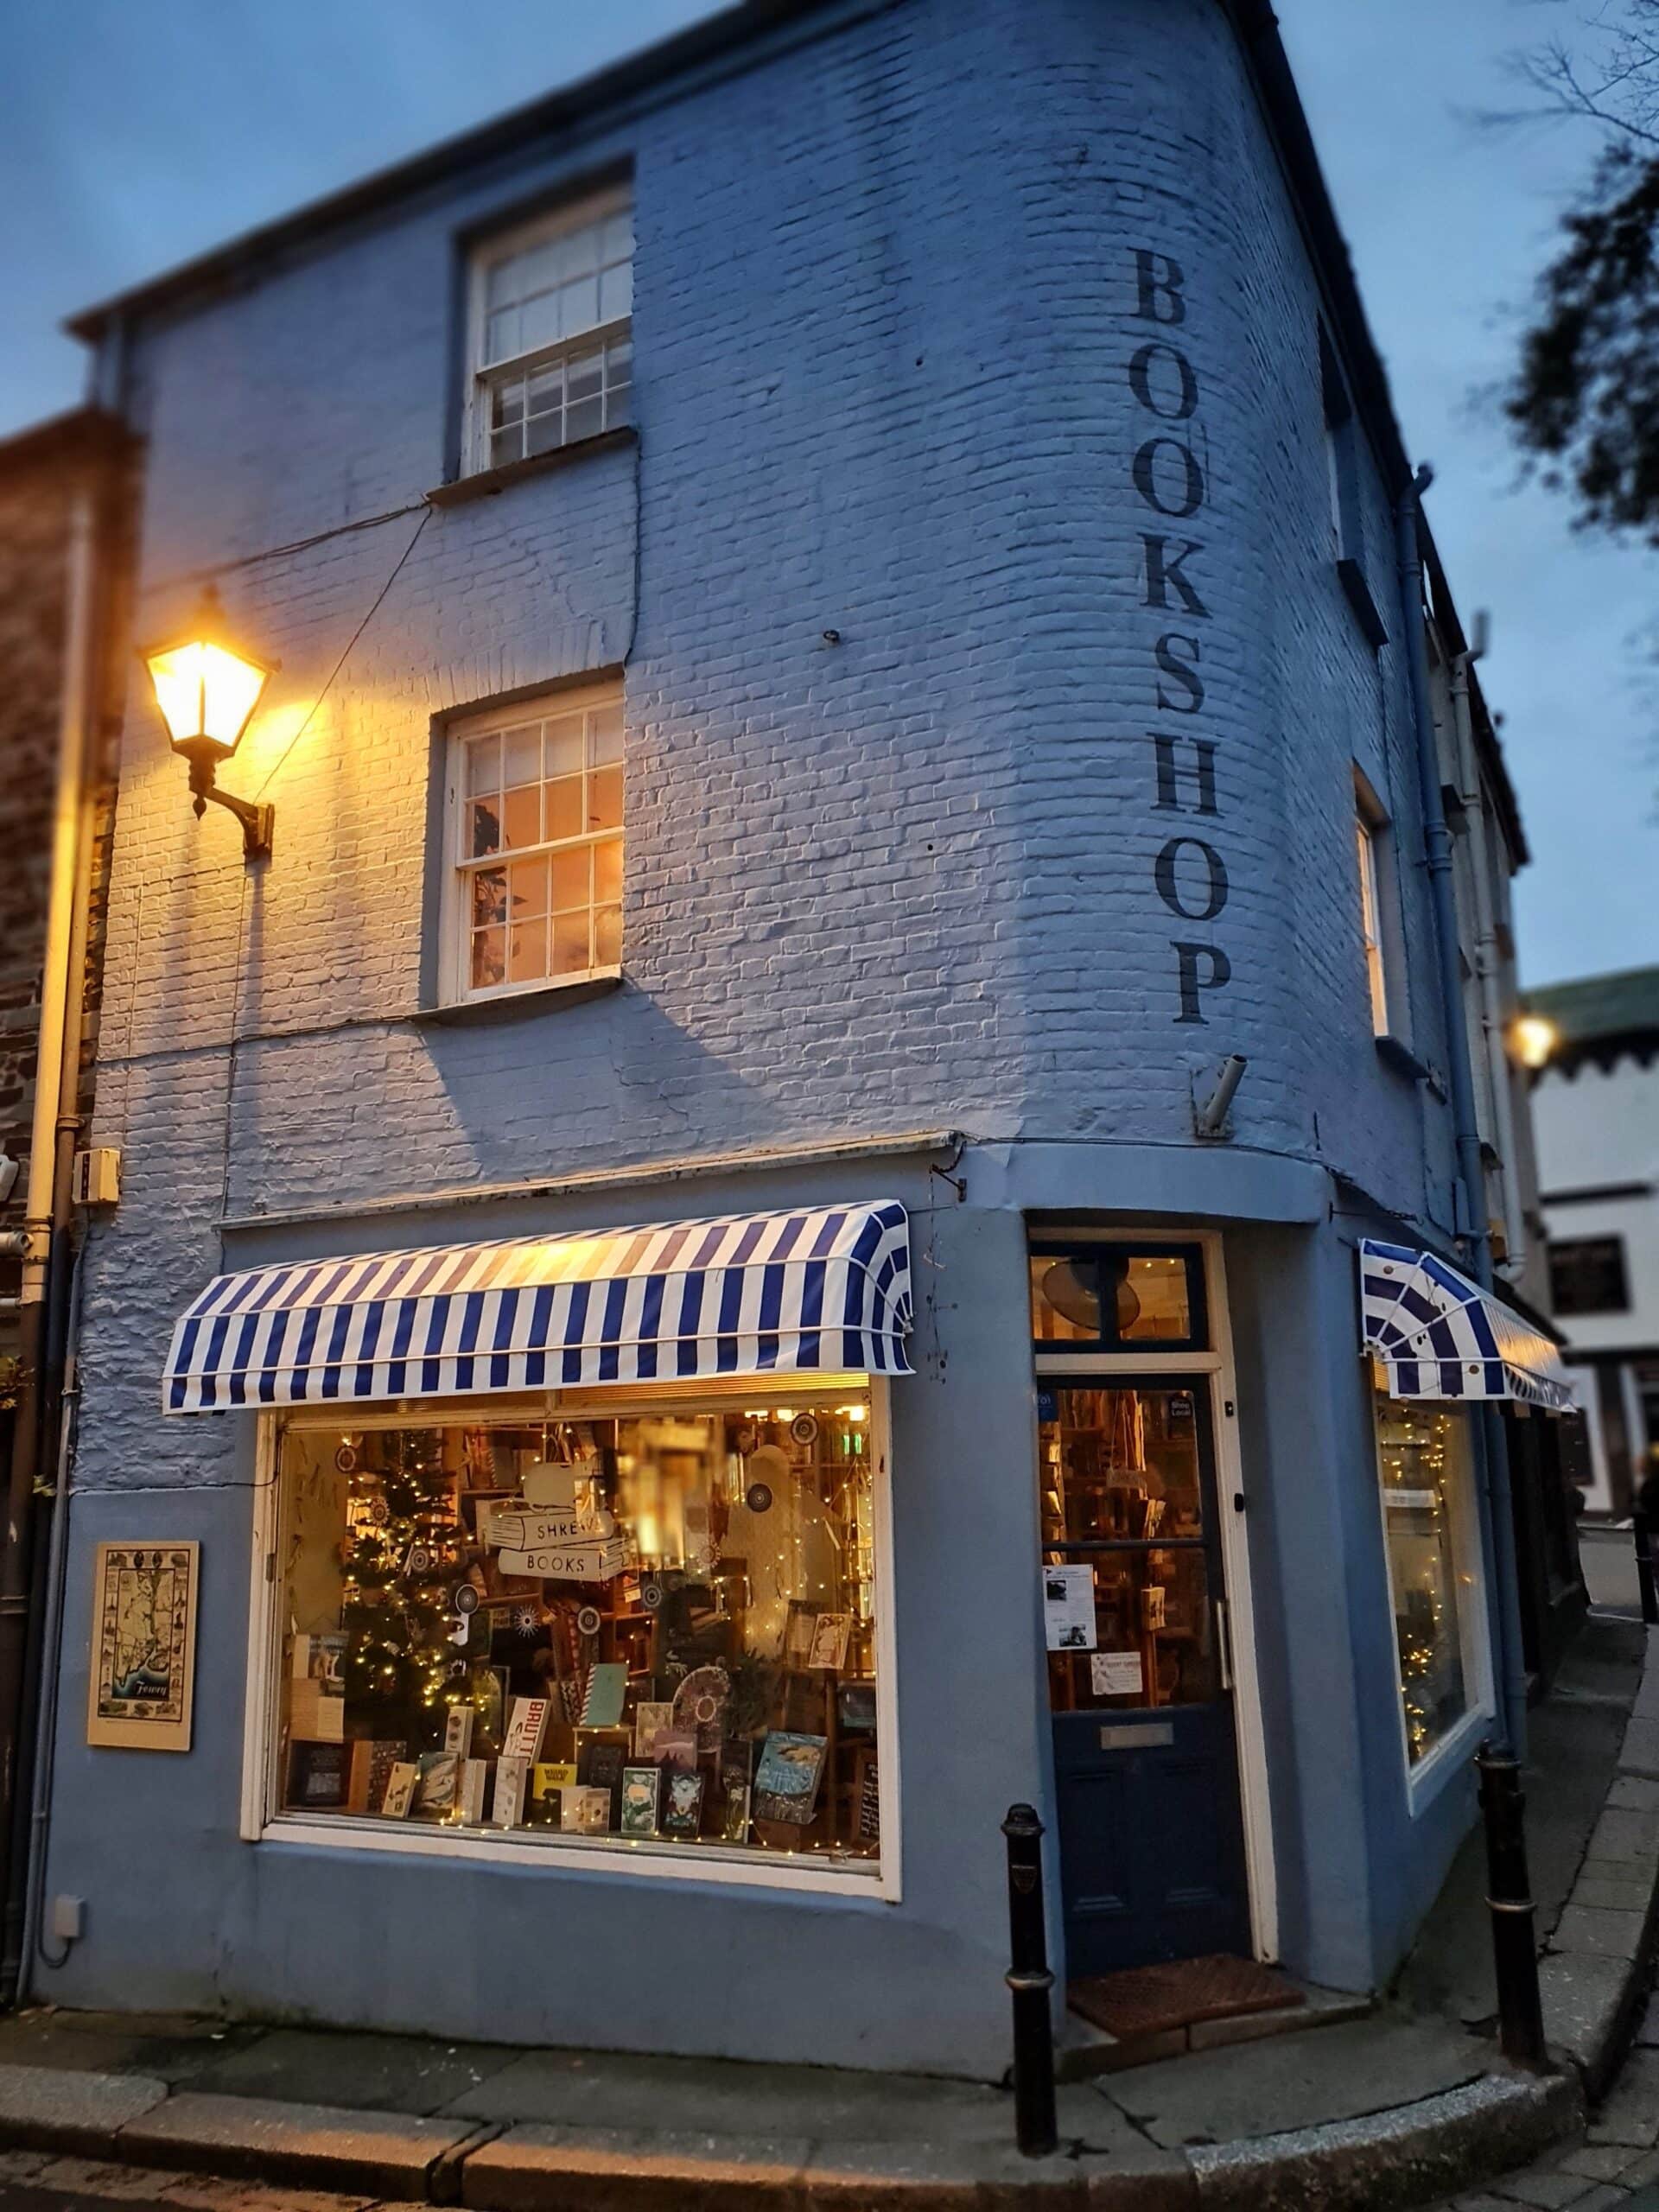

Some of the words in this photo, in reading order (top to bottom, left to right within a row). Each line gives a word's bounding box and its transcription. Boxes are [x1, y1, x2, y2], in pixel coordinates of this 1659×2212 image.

[1126, 247, 1231, 1025] BOOKSHOP
[527, 1554, 585, 1573] BOOKS
[518, 1701, 544, 1766] BRUTT
